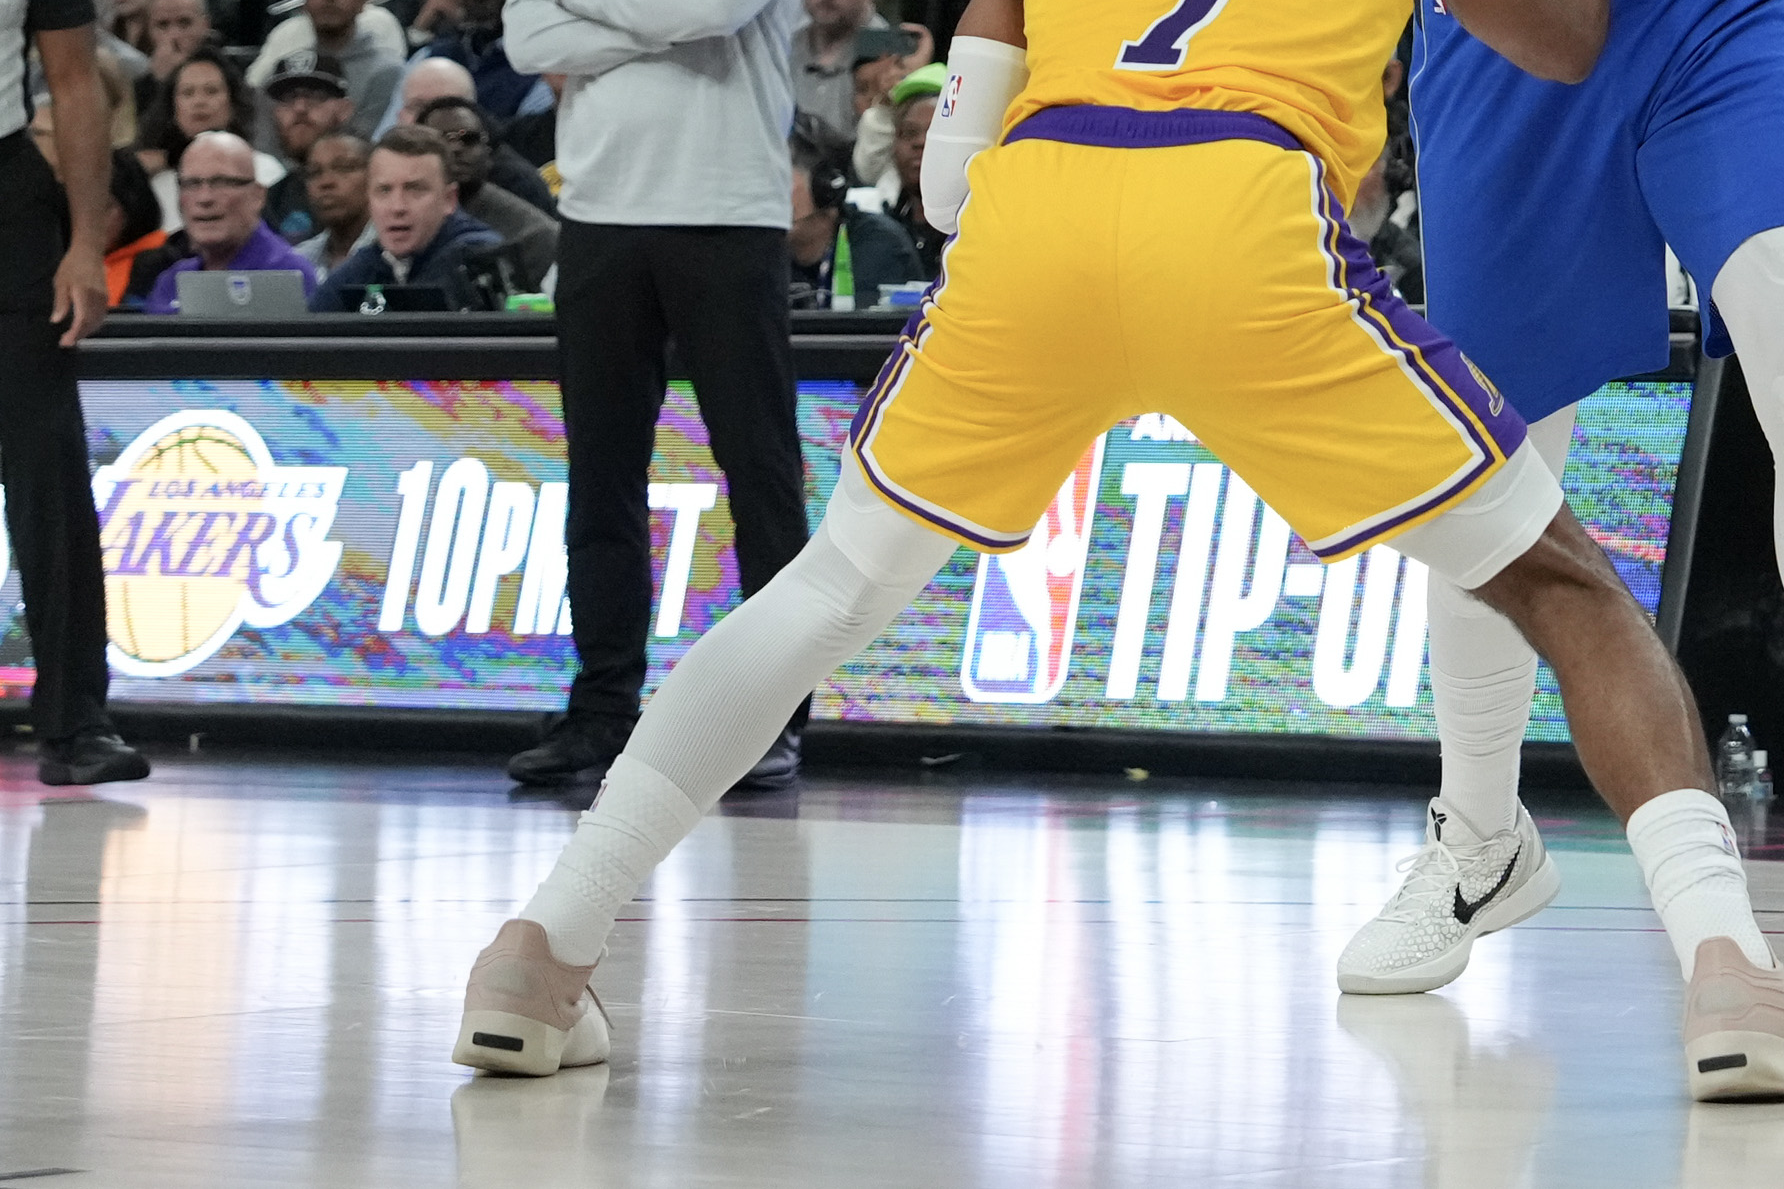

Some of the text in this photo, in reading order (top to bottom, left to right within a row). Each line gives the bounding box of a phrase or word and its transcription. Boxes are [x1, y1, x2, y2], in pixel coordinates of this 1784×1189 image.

[150, 481, 327, 499] LOS ANGELES
[647, 483, 718, 638] T
